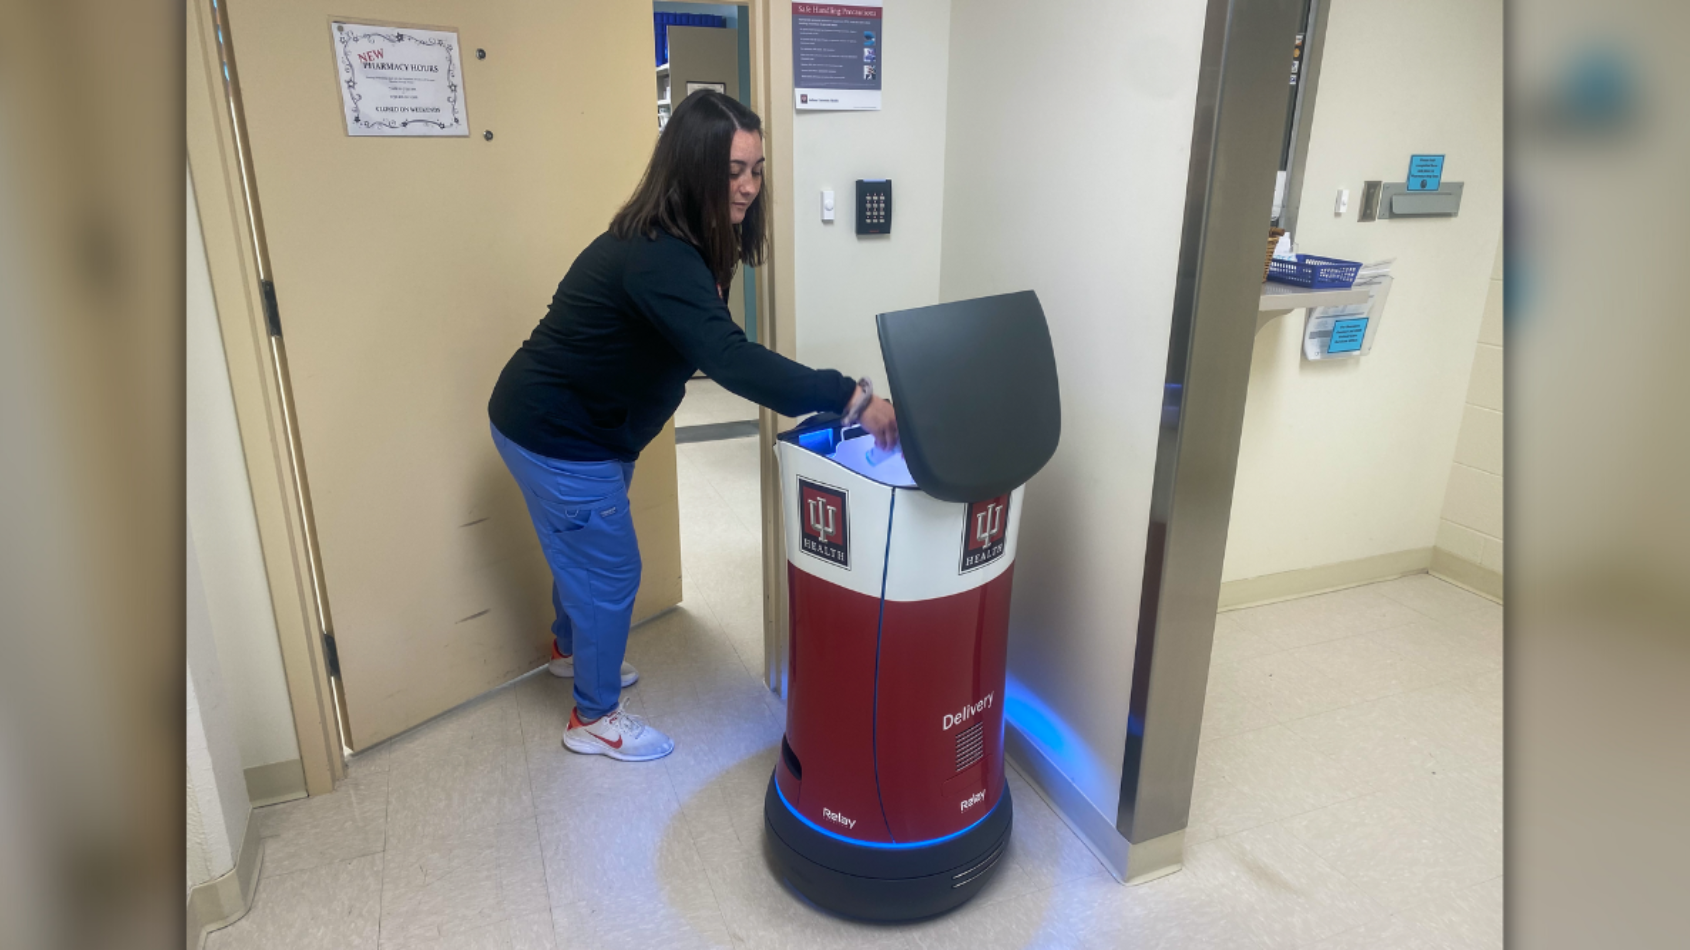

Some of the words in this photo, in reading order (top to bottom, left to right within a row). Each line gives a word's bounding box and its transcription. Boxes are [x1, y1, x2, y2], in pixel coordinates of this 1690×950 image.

[798, 5, 811, 14] Safe
[813, 6, 841, 16] Handling
[357, 48, 384, 63] NEW
[363, 62, 409, 72] PHARMACY
[410, 63, 439, 73] HOURS
[803, 538, 845, 562] HEALTH
[965, 542, 1004, 566] HEALTH
[943, 691, 995, 731] Delivery
[960, 789, 987, 811] Relay
[822, 807, 857, 829] Relay
